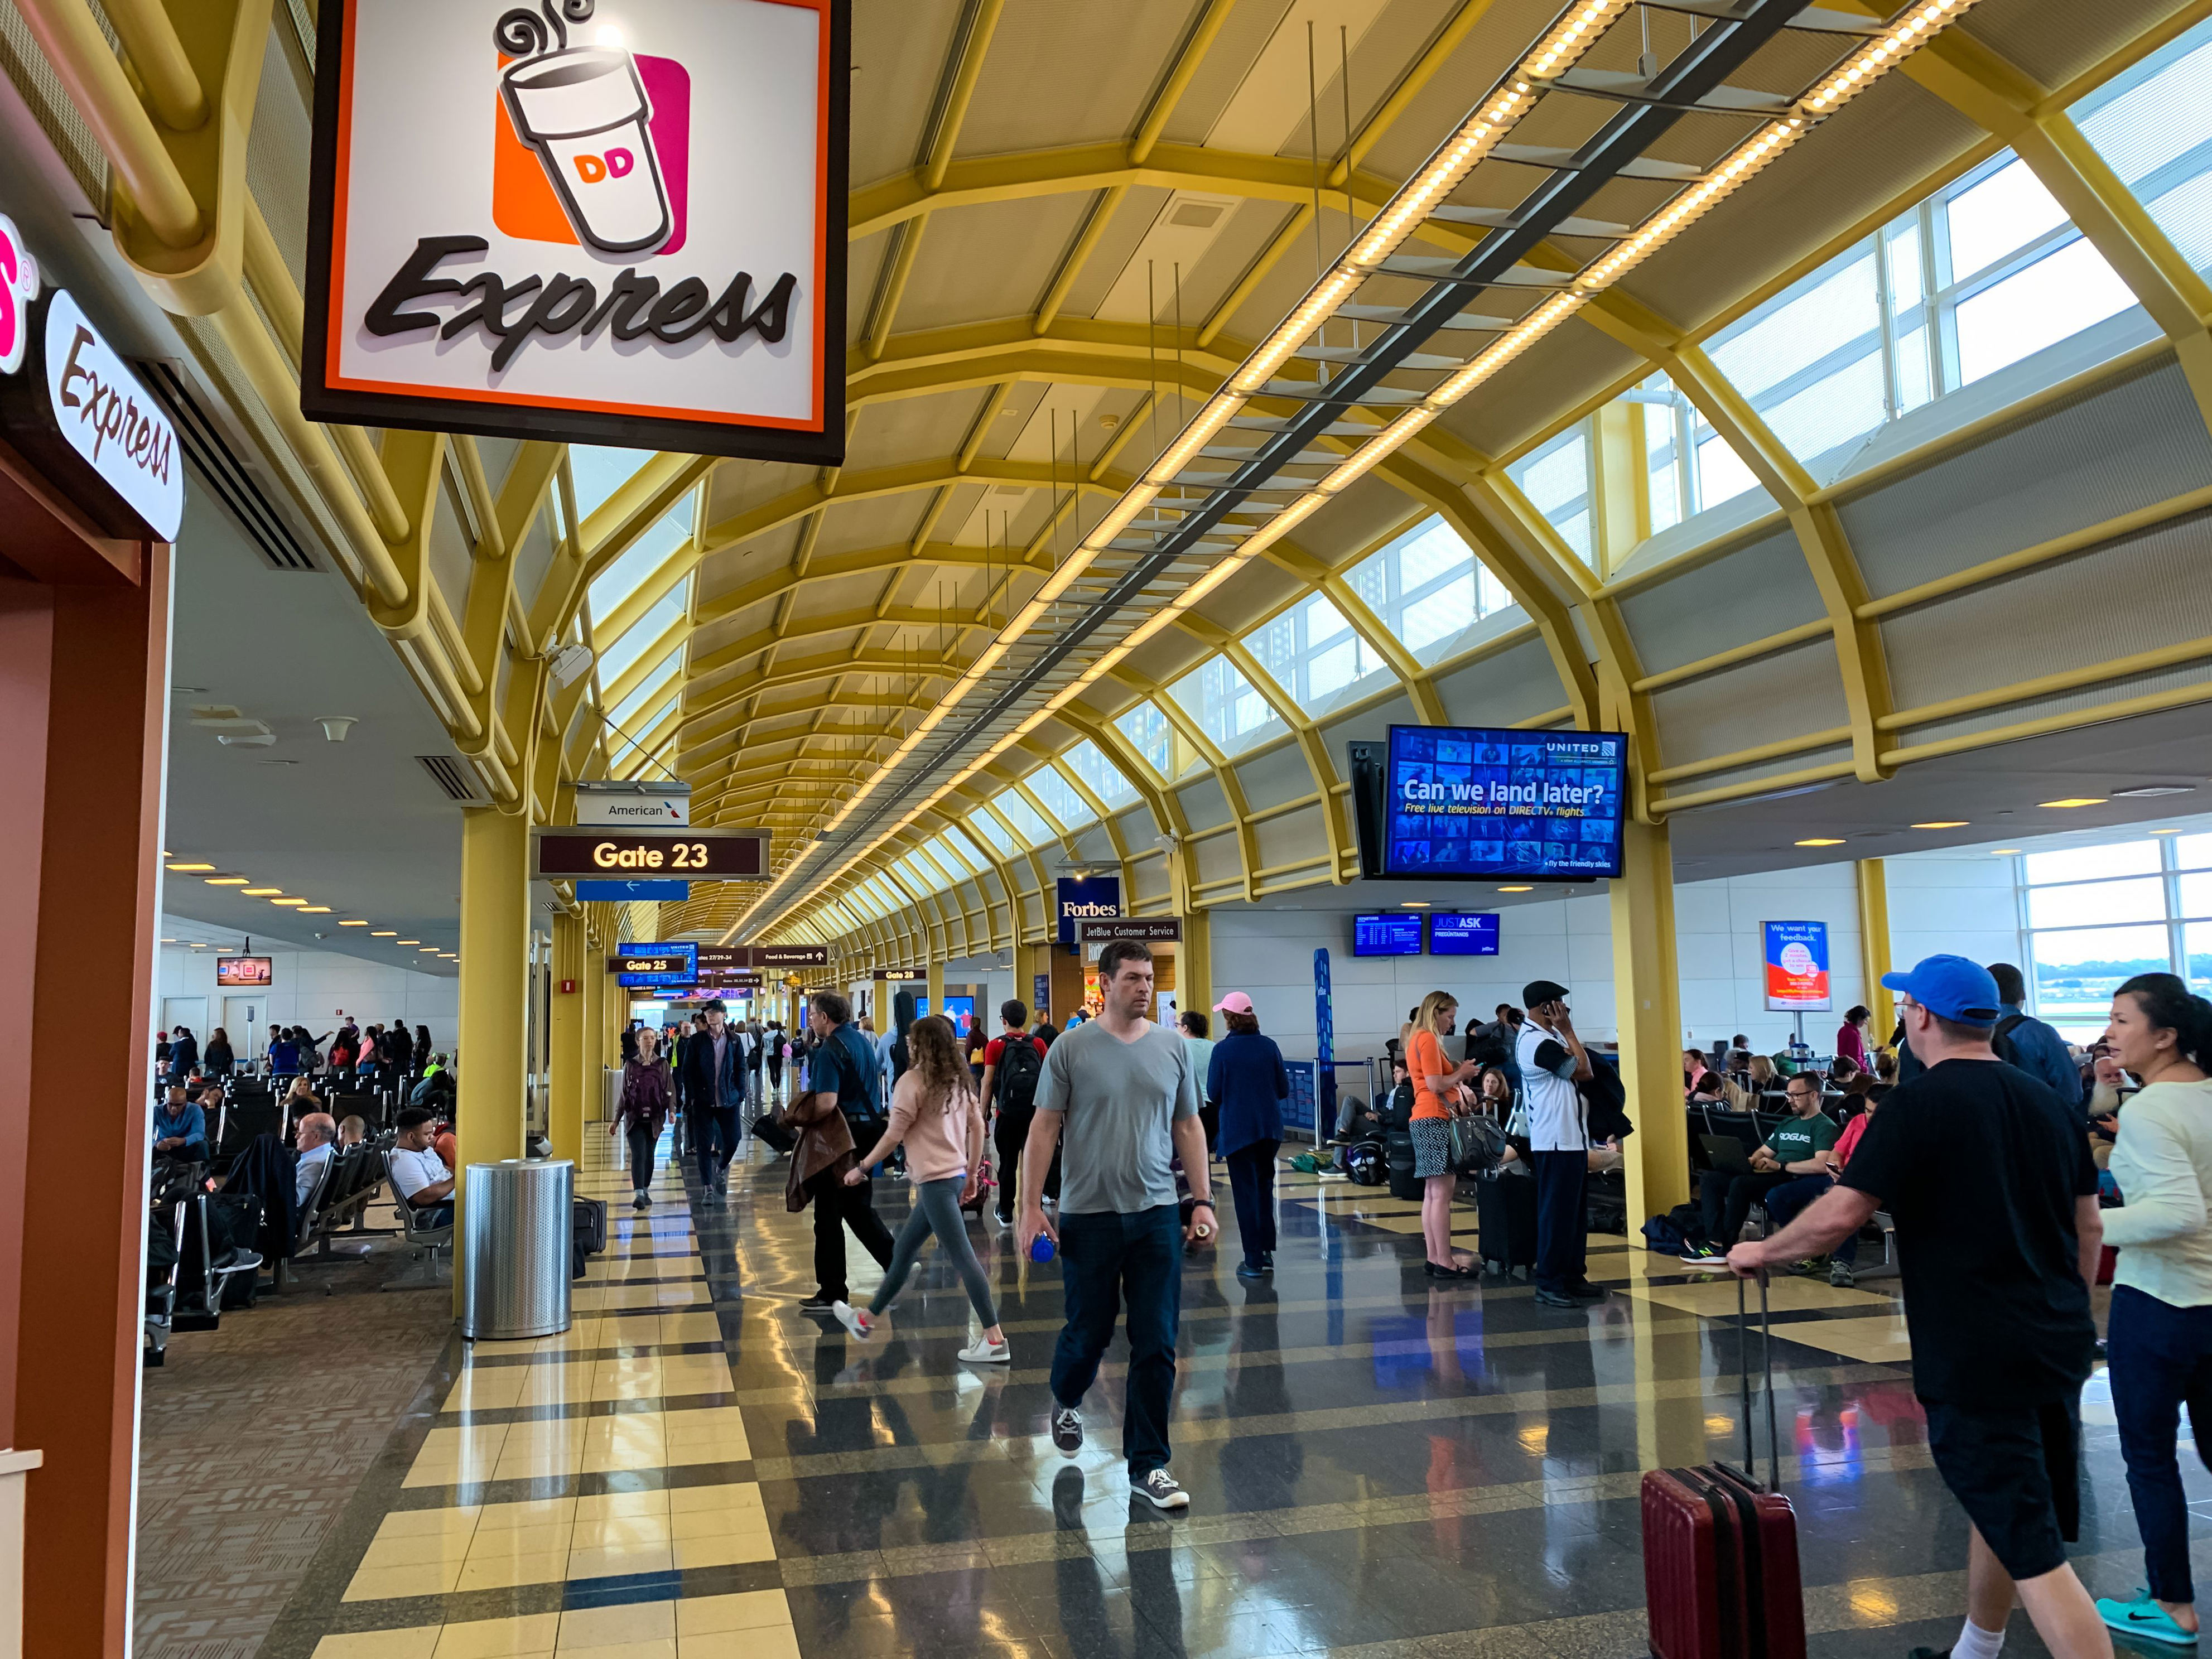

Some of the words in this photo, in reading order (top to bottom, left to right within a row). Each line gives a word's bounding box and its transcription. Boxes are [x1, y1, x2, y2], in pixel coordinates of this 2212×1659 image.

[572, 147, 634, 183] DD
[364, 235, 797, 372] Express
[60, 323, 171, 485] Express
[1546, 743, 1599, 753] UNITED
[1404, 779, 1444, 800] Can
[1452, 784, 1483, 801] we
[1490, 780, 1536, 802] land
[1543, 782, 1604, 804] later?
[609, 806, 662, 816] American
[1404, 803, 1425, 813] Free
[1428, 803, 1444, 813] live
[1448, 804, 1491, 814] television
[594, 842, 663, 867] Gate
[672, 843, 708, 867] 23
[1062, 902, 1116, 917] Forbes
[1086, 927, 1111, 937] JetBlue
[1114, 927, 1146, 936] Customer
[1149, 926, 1174, 936] Service
[627, 961, 652, 970] Gate
[653, 960, 667, 970] 25
[1779, 1132, 1811, 1143] ROGUE
